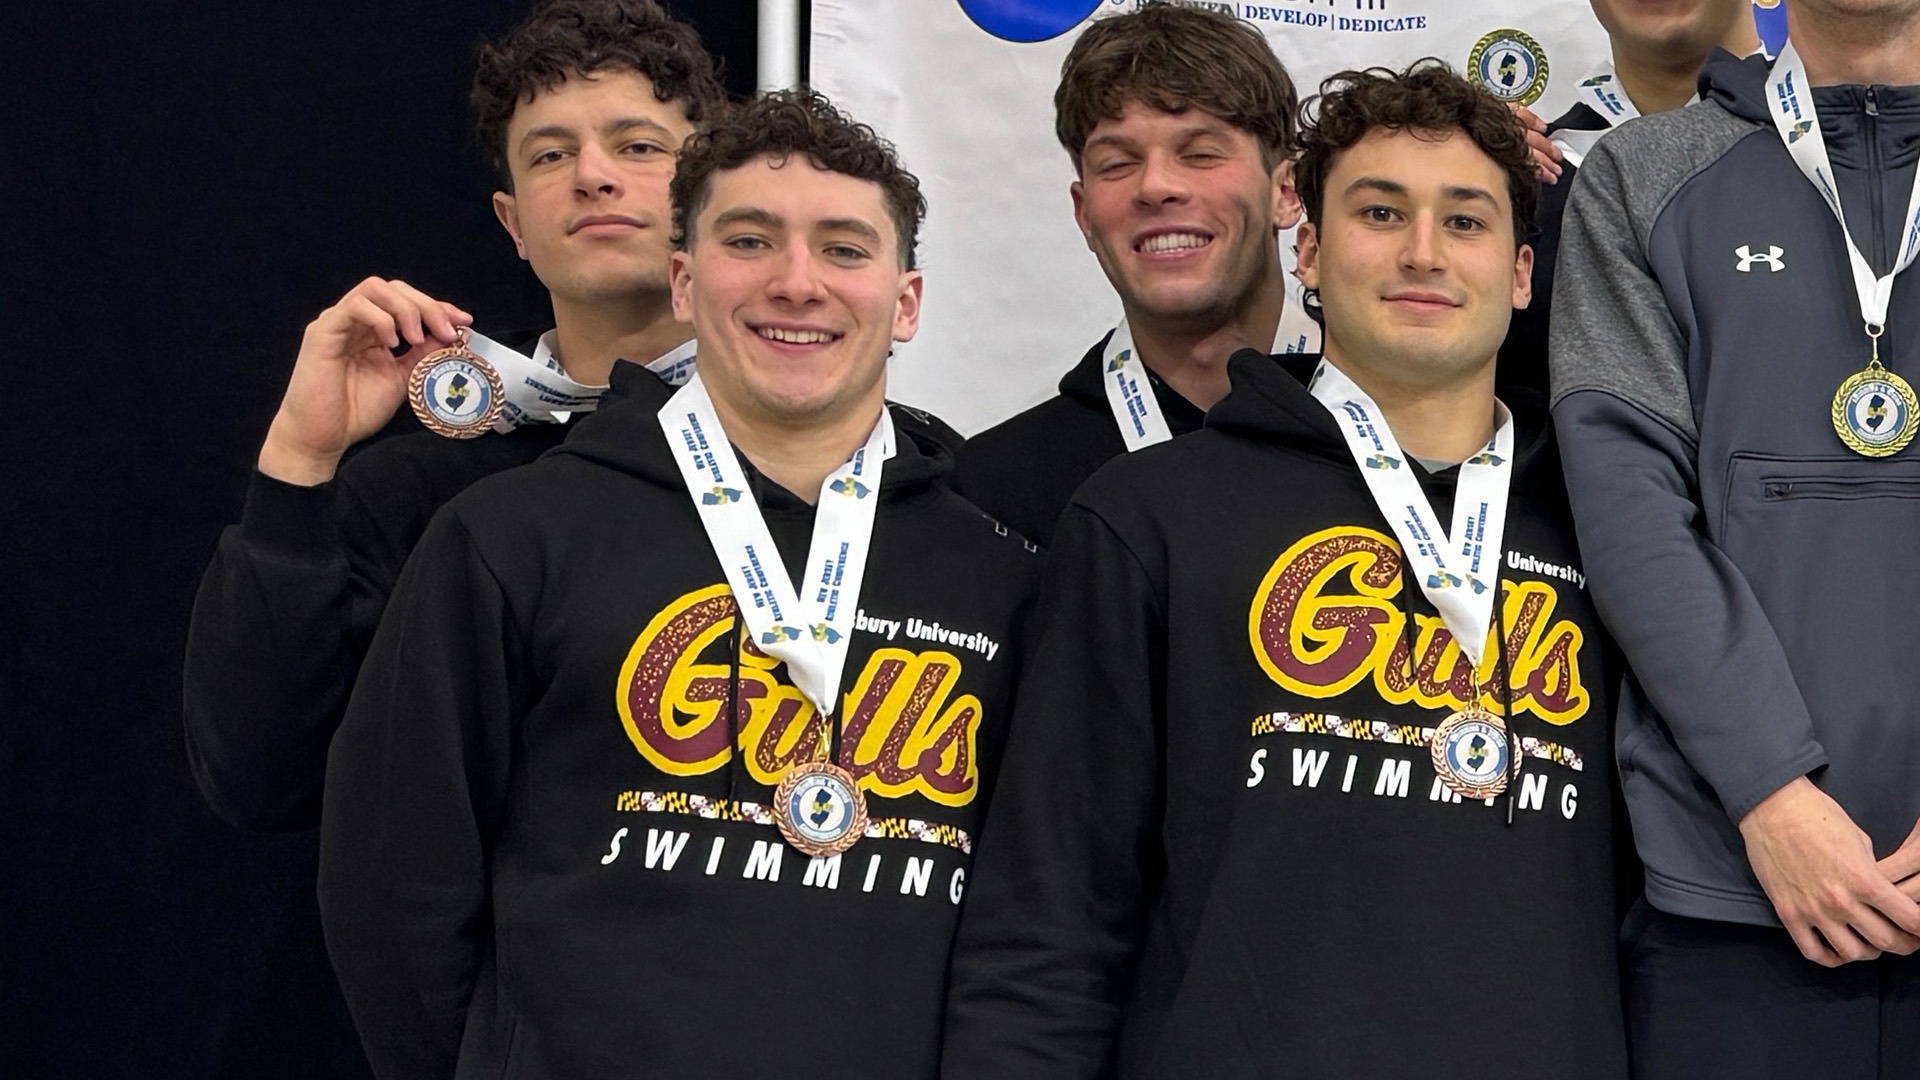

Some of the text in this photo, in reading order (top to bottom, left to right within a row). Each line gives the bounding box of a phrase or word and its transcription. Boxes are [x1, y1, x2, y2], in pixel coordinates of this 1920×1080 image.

[1245, 5, 1327, 27] DEVELOP
[1338, 16, 1426, 32] DEDICATE
[1507, 551, 1586, 590] University
[853, 609, 999, 661] bury University
[616, 583, 983, 807] Gulls
[1247, 748, 1578, 819] SWIMNG
[601, 828, 965, 904] SWIMMING
